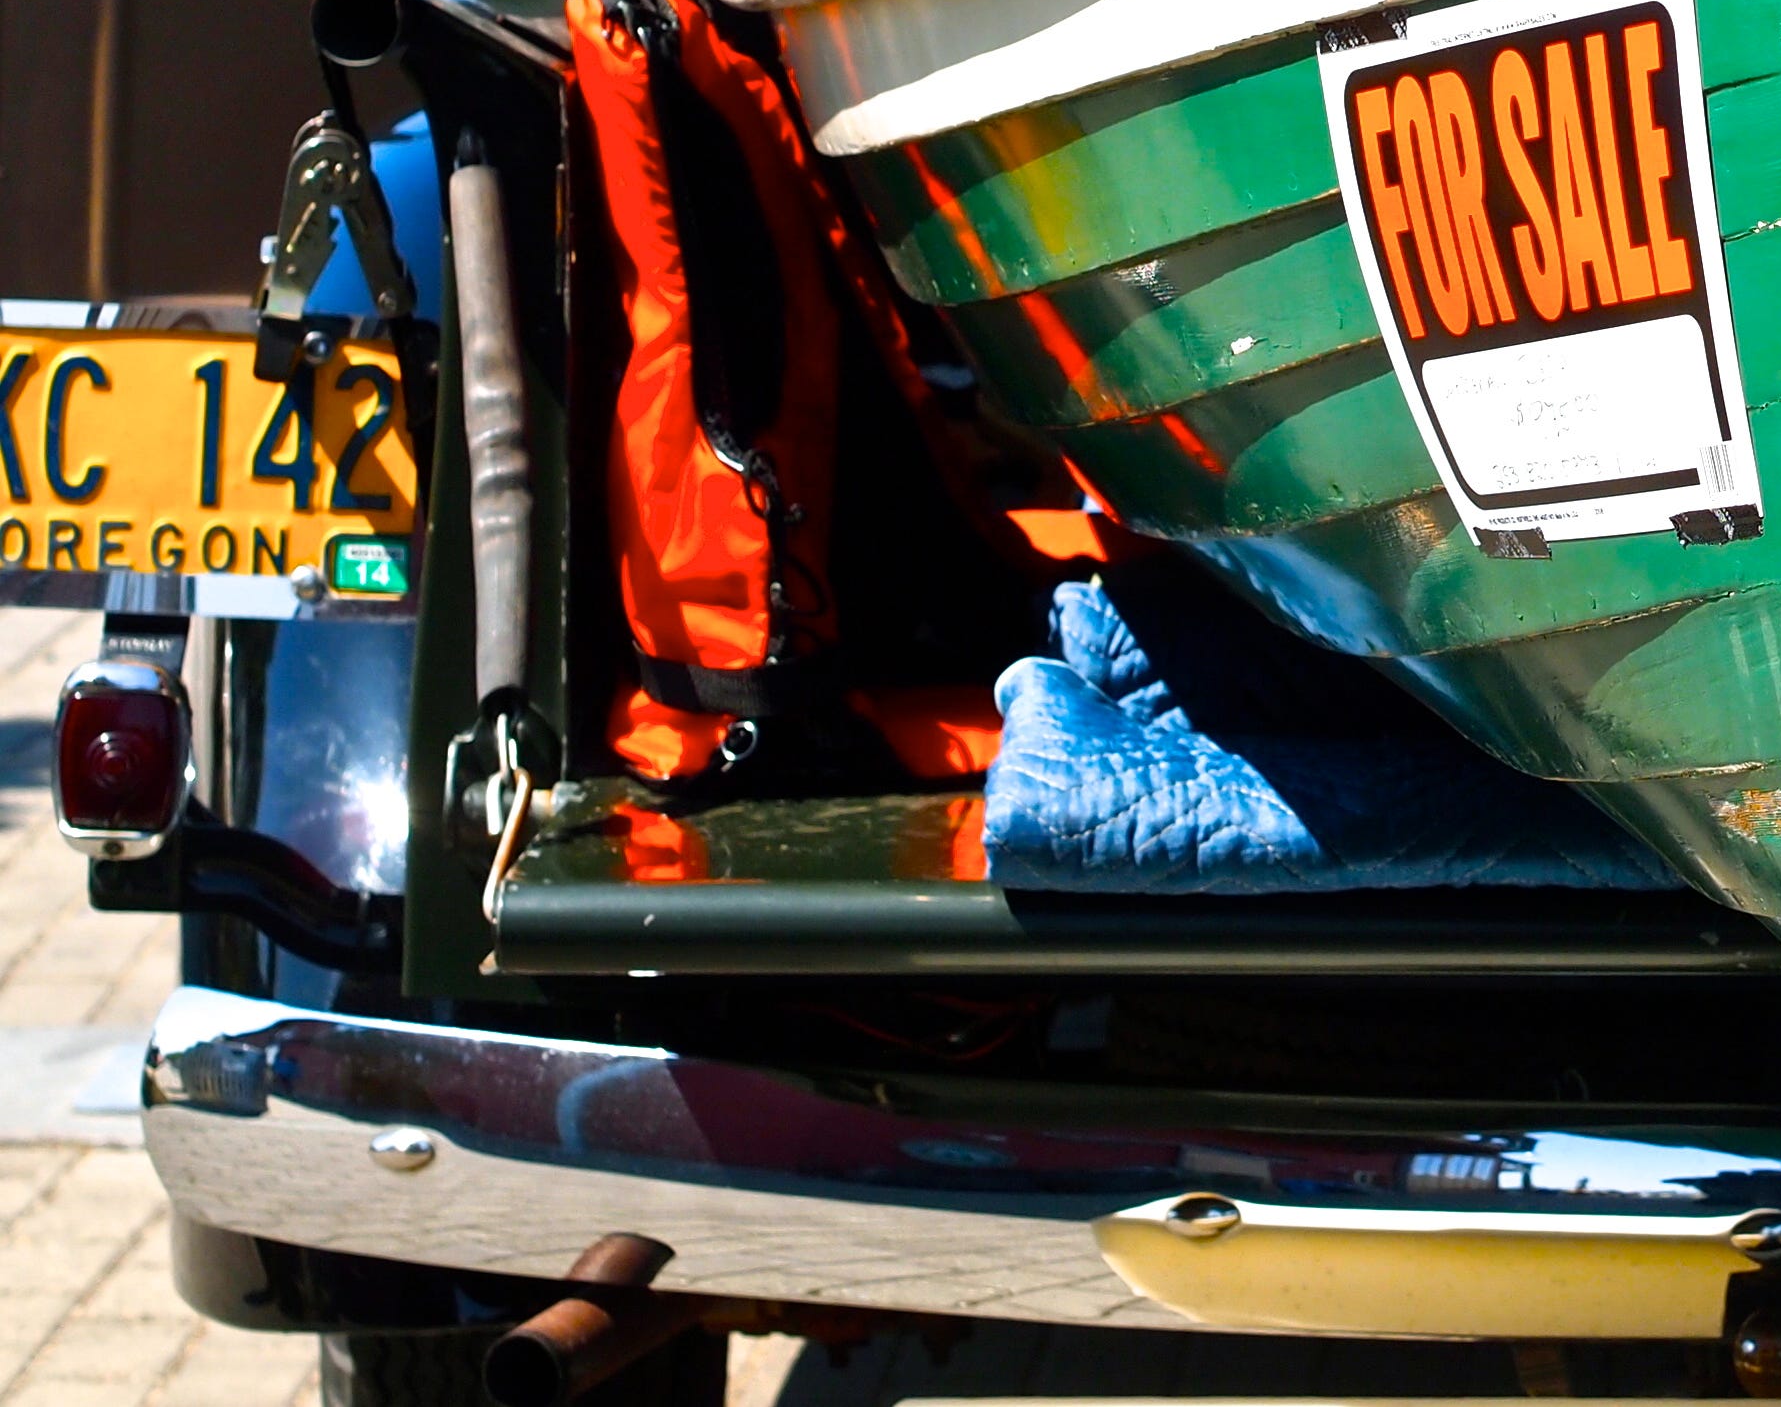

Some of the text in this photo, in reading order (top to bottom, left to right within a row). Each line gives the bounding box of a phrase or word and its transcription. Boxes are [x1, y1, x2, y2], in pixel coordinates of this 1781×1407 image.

[1354, 21, 1694, 339] FOR SALE
[196, 358, 393, 512] 142
[0, 518, 287, 574] OREGON
[355, 561, 391, 587] 14
